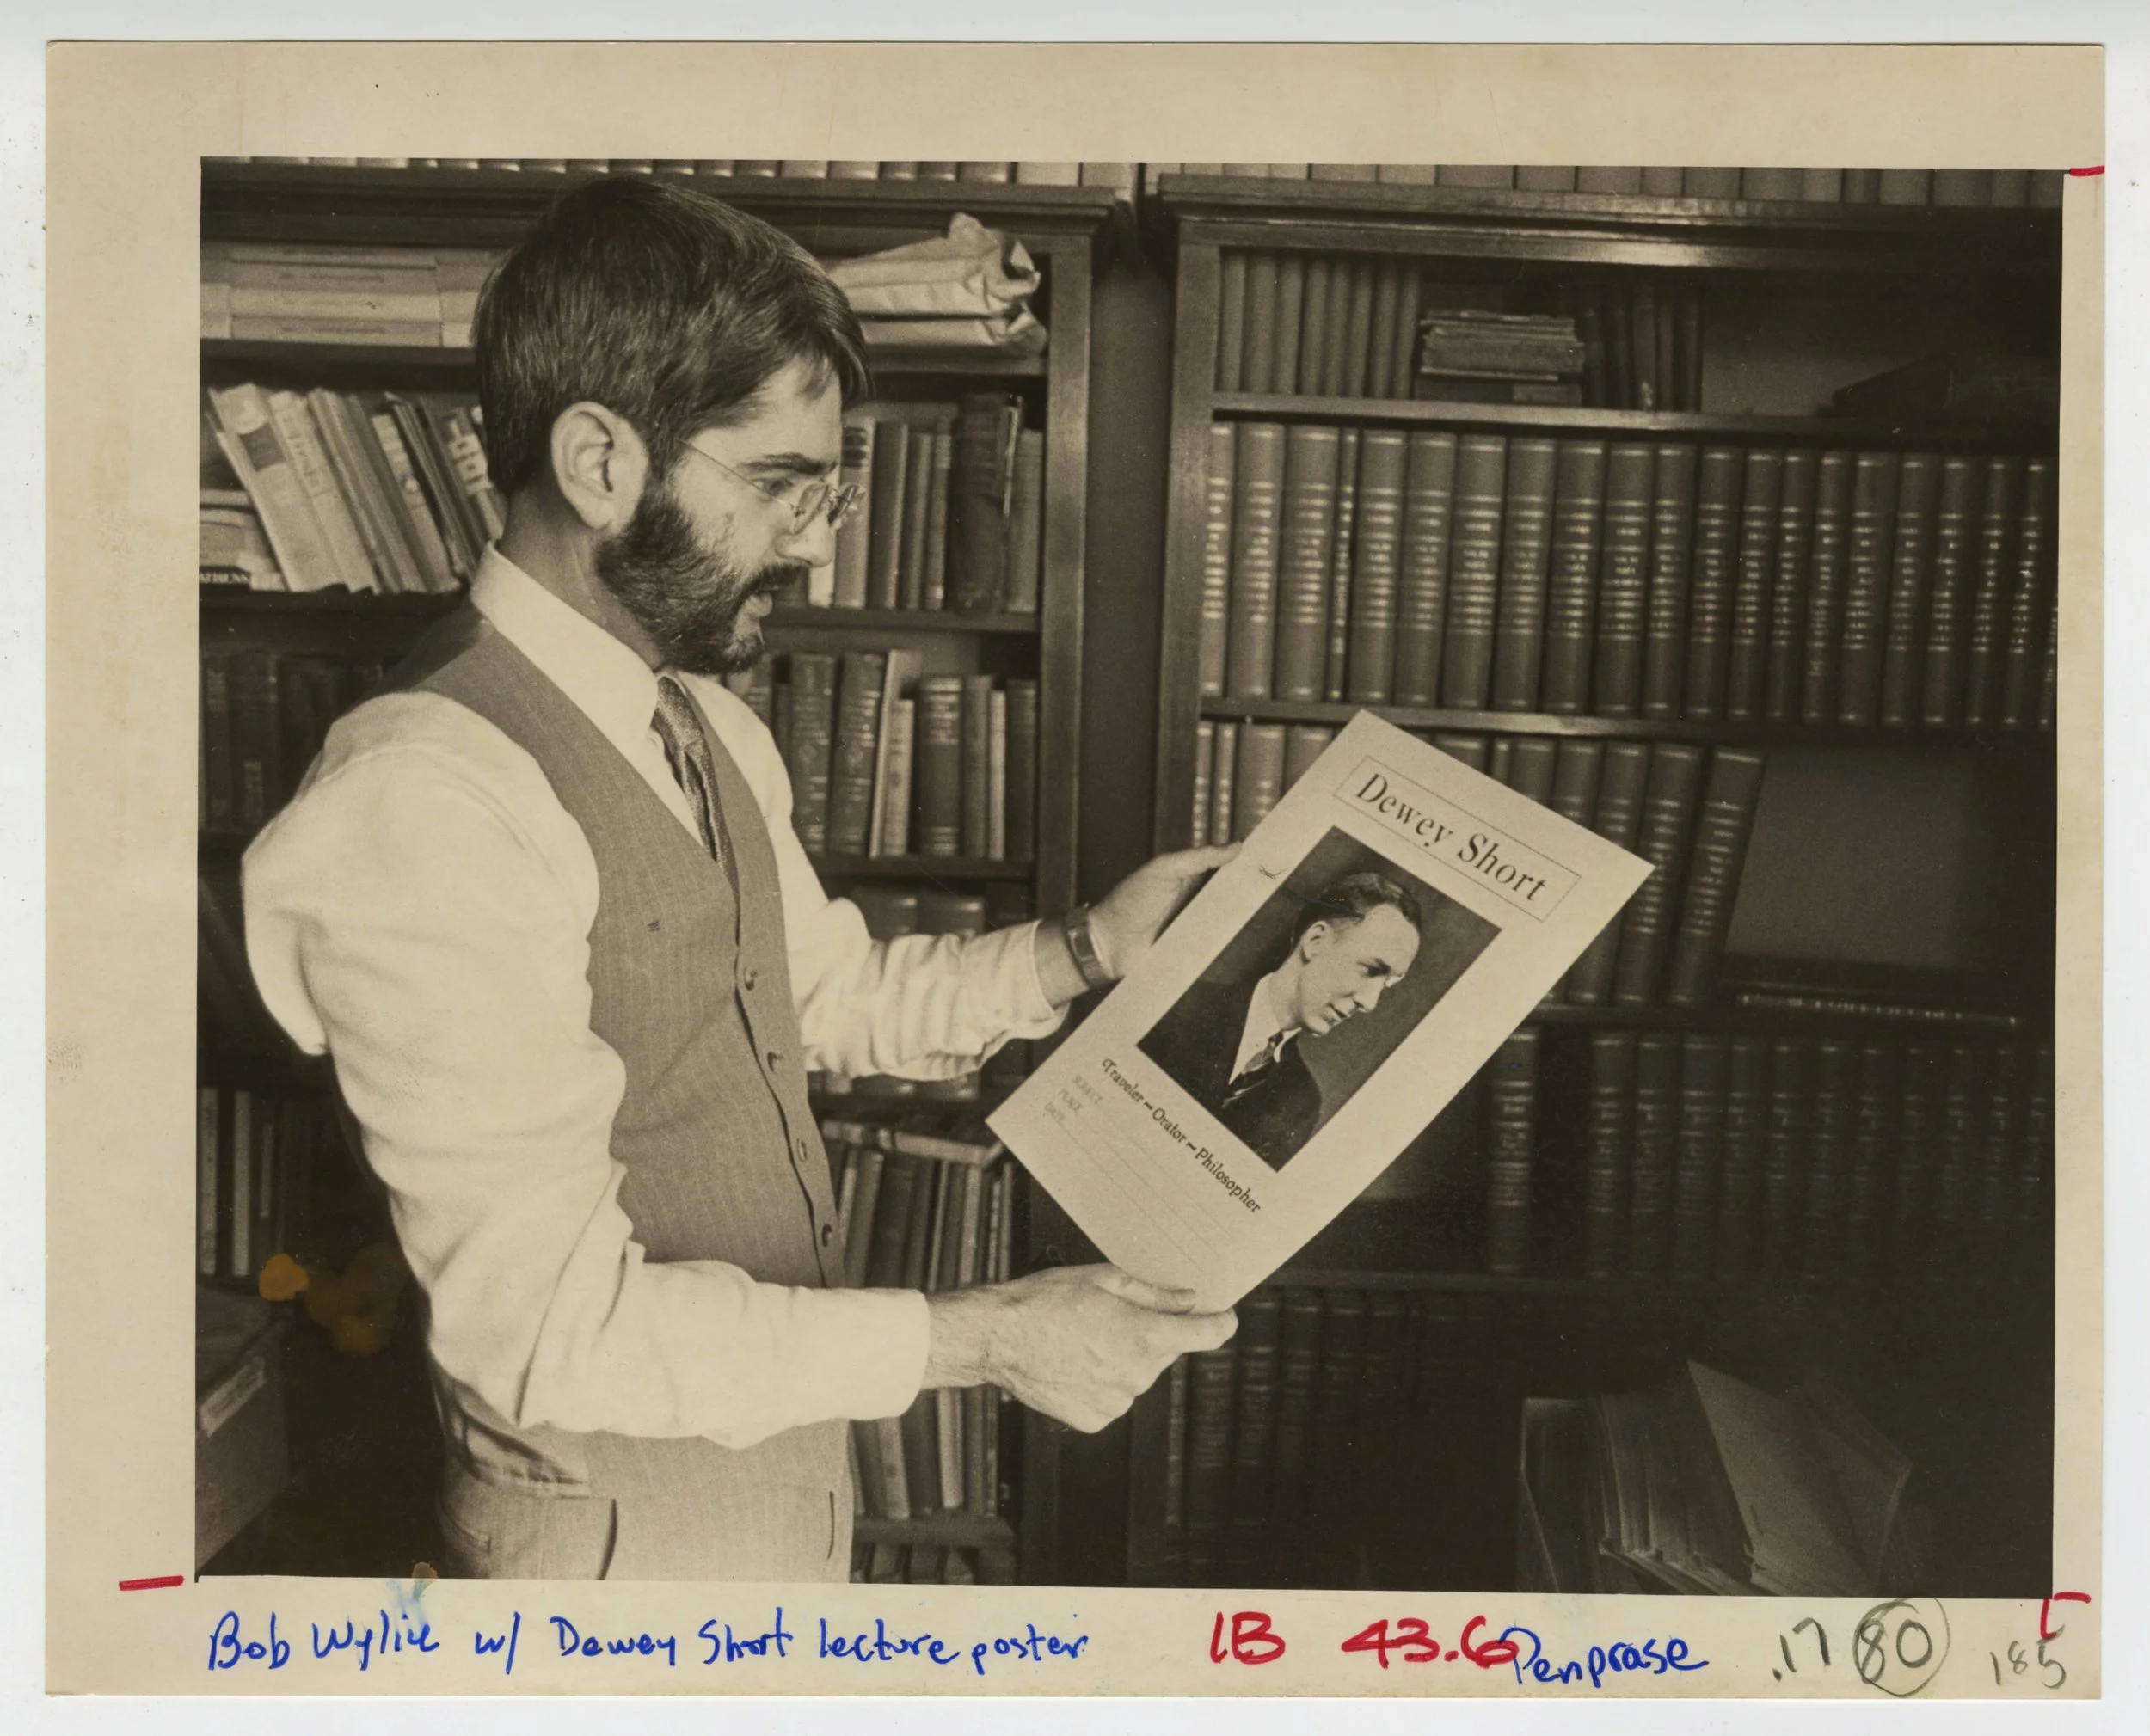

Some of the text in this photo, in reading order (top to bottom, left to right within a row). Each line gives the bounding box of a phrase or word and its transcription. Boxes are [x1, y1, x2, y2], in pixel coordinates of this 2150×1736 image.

[1356, 773, 1453, 848] Dewey
[1457, 832, 1547, 901] Short
[1102, 1058, 1145, 1103] Traveler
[1152, 1107, 1188, 1144] Orator
[1194, 1147, 1262, 1213] Philosopher
[209, 1611, 291, 1671] Bob
[475, 1611, 521, 1675] w/
[550, 1616, 676, 1668] Dewey
[698, 1607, 794, 1665] Short
[820, 1618, 961, 1665] lecture
[972, 1623, 1089, 1676] poster
[1499, 1627, 1709, 1688] Penprase
[1859, 1617, 1934, 1684] 80
